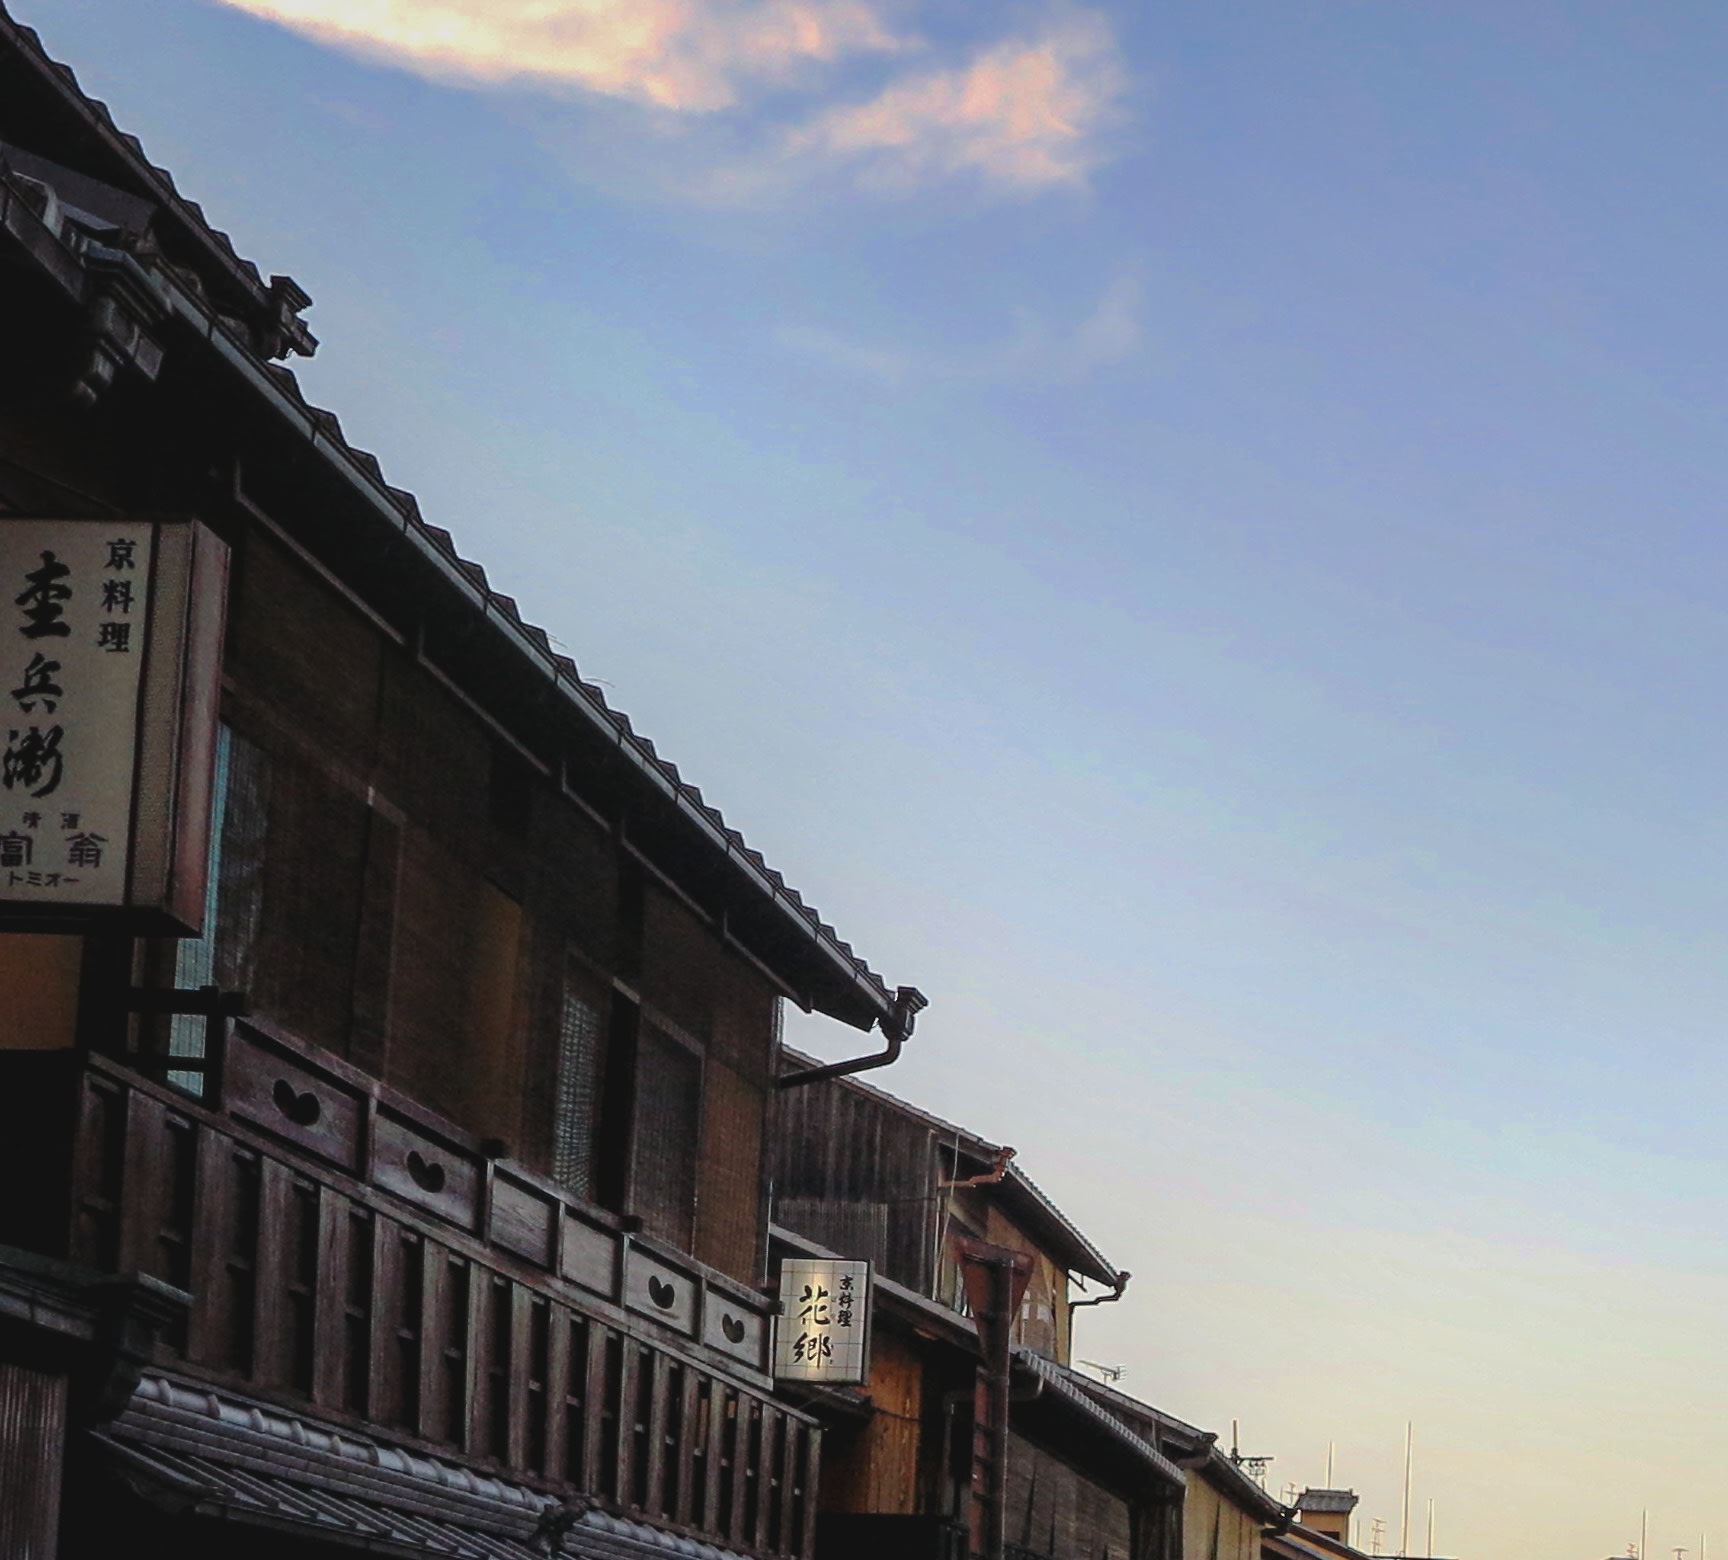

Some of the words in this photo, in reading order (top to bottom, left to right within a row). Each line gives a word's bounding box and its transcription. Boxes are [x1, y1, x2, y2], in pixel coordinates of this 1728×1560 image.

[97, 537, 138, 654] 京料理
[9, 870, 80, 887] トミオー
[837, 1274, 854, 1328] 京料理
